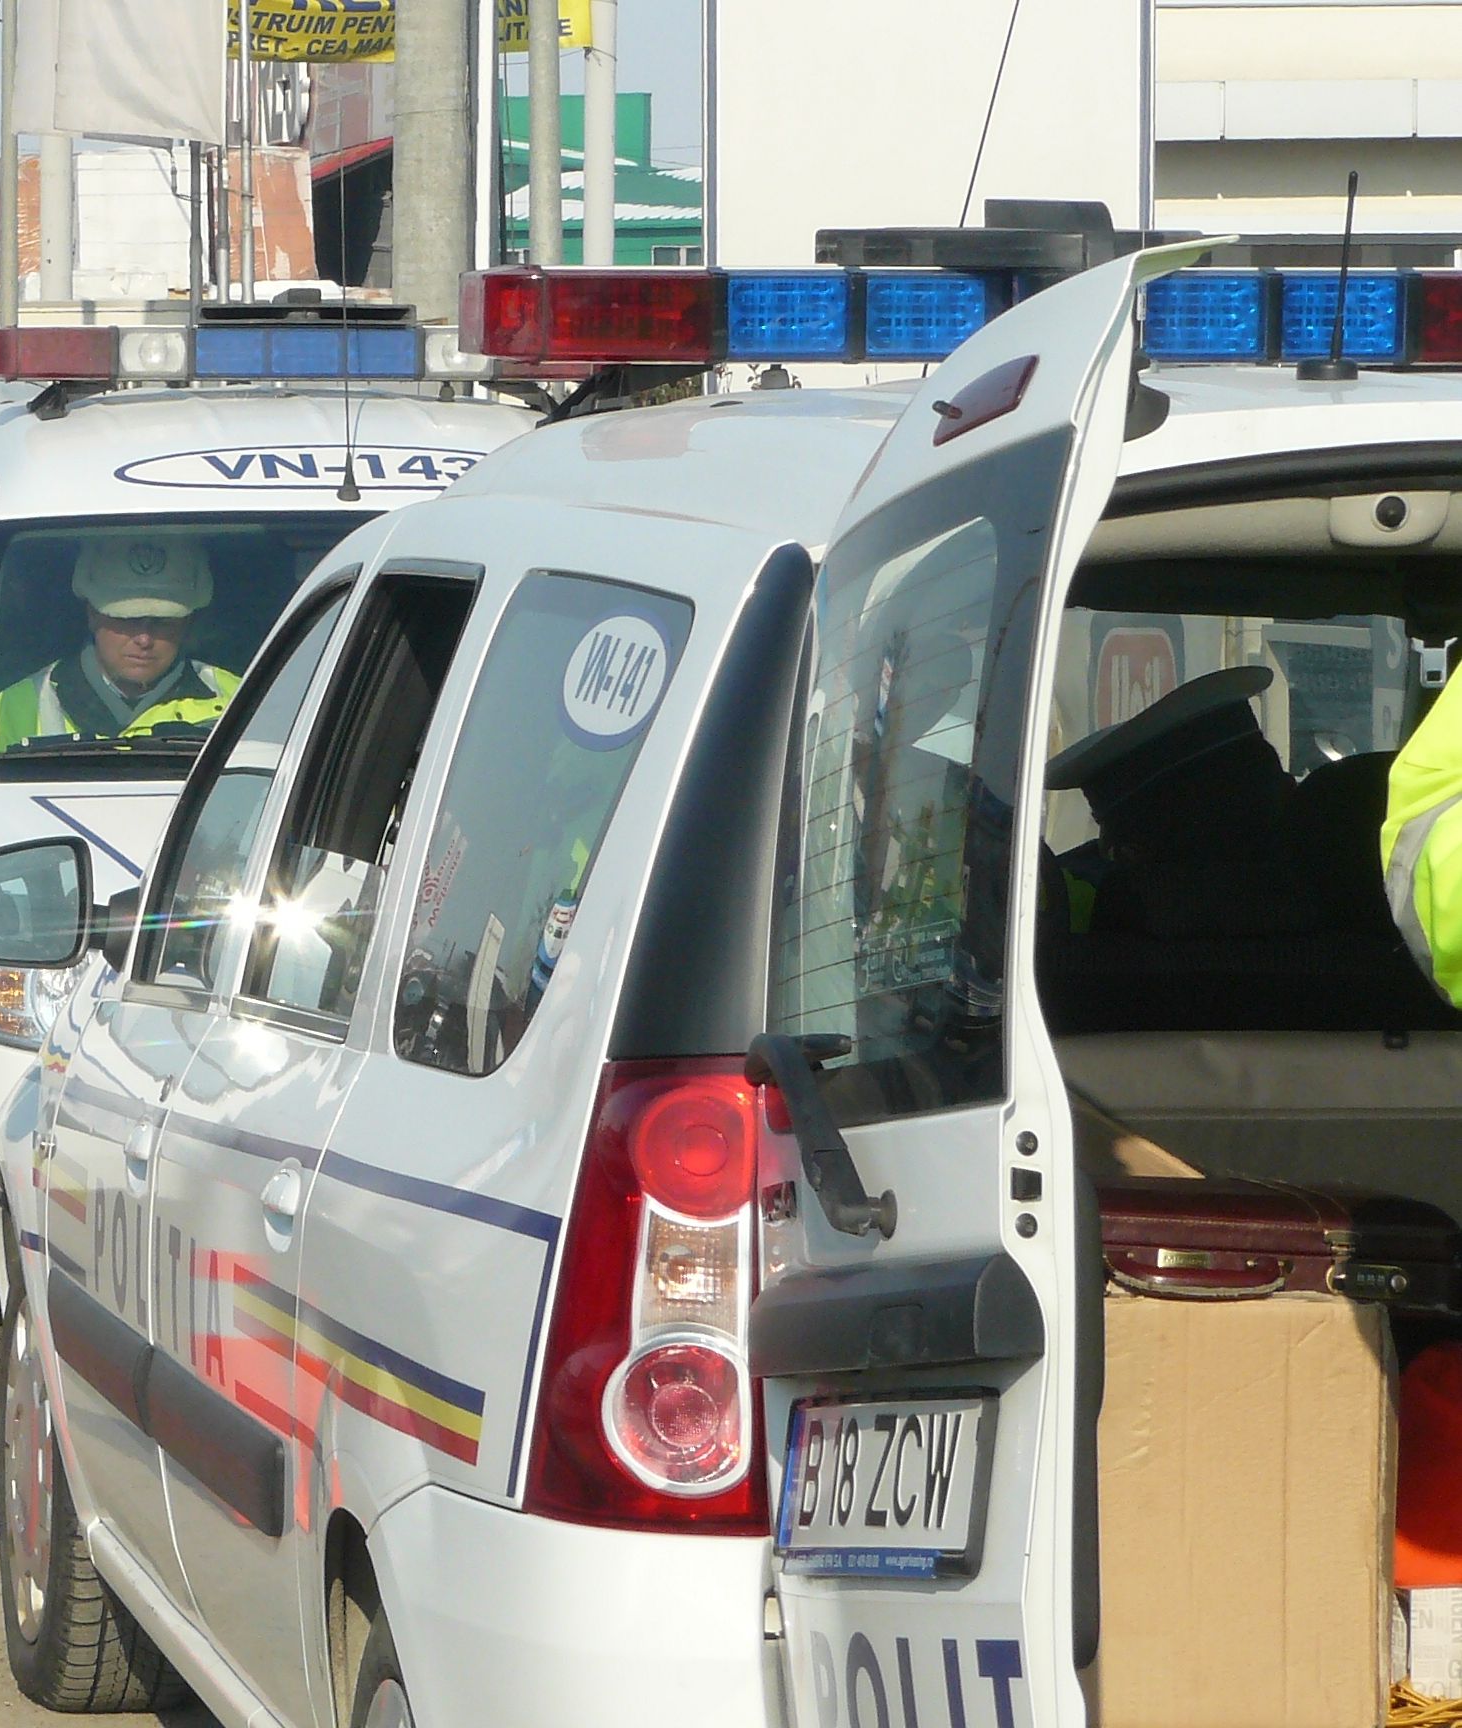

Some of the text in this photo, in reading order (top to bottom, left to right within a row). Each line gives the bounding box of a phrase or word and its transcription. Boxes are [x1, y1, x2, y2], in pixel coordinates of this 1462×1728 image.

[307, 38, 347, 56] CEA
[574, 631, 658, 717] VN-141
[94, 1177, 225, 1387] POLITIA
[798, 1413, 963, 1529] B 18 ZCW
